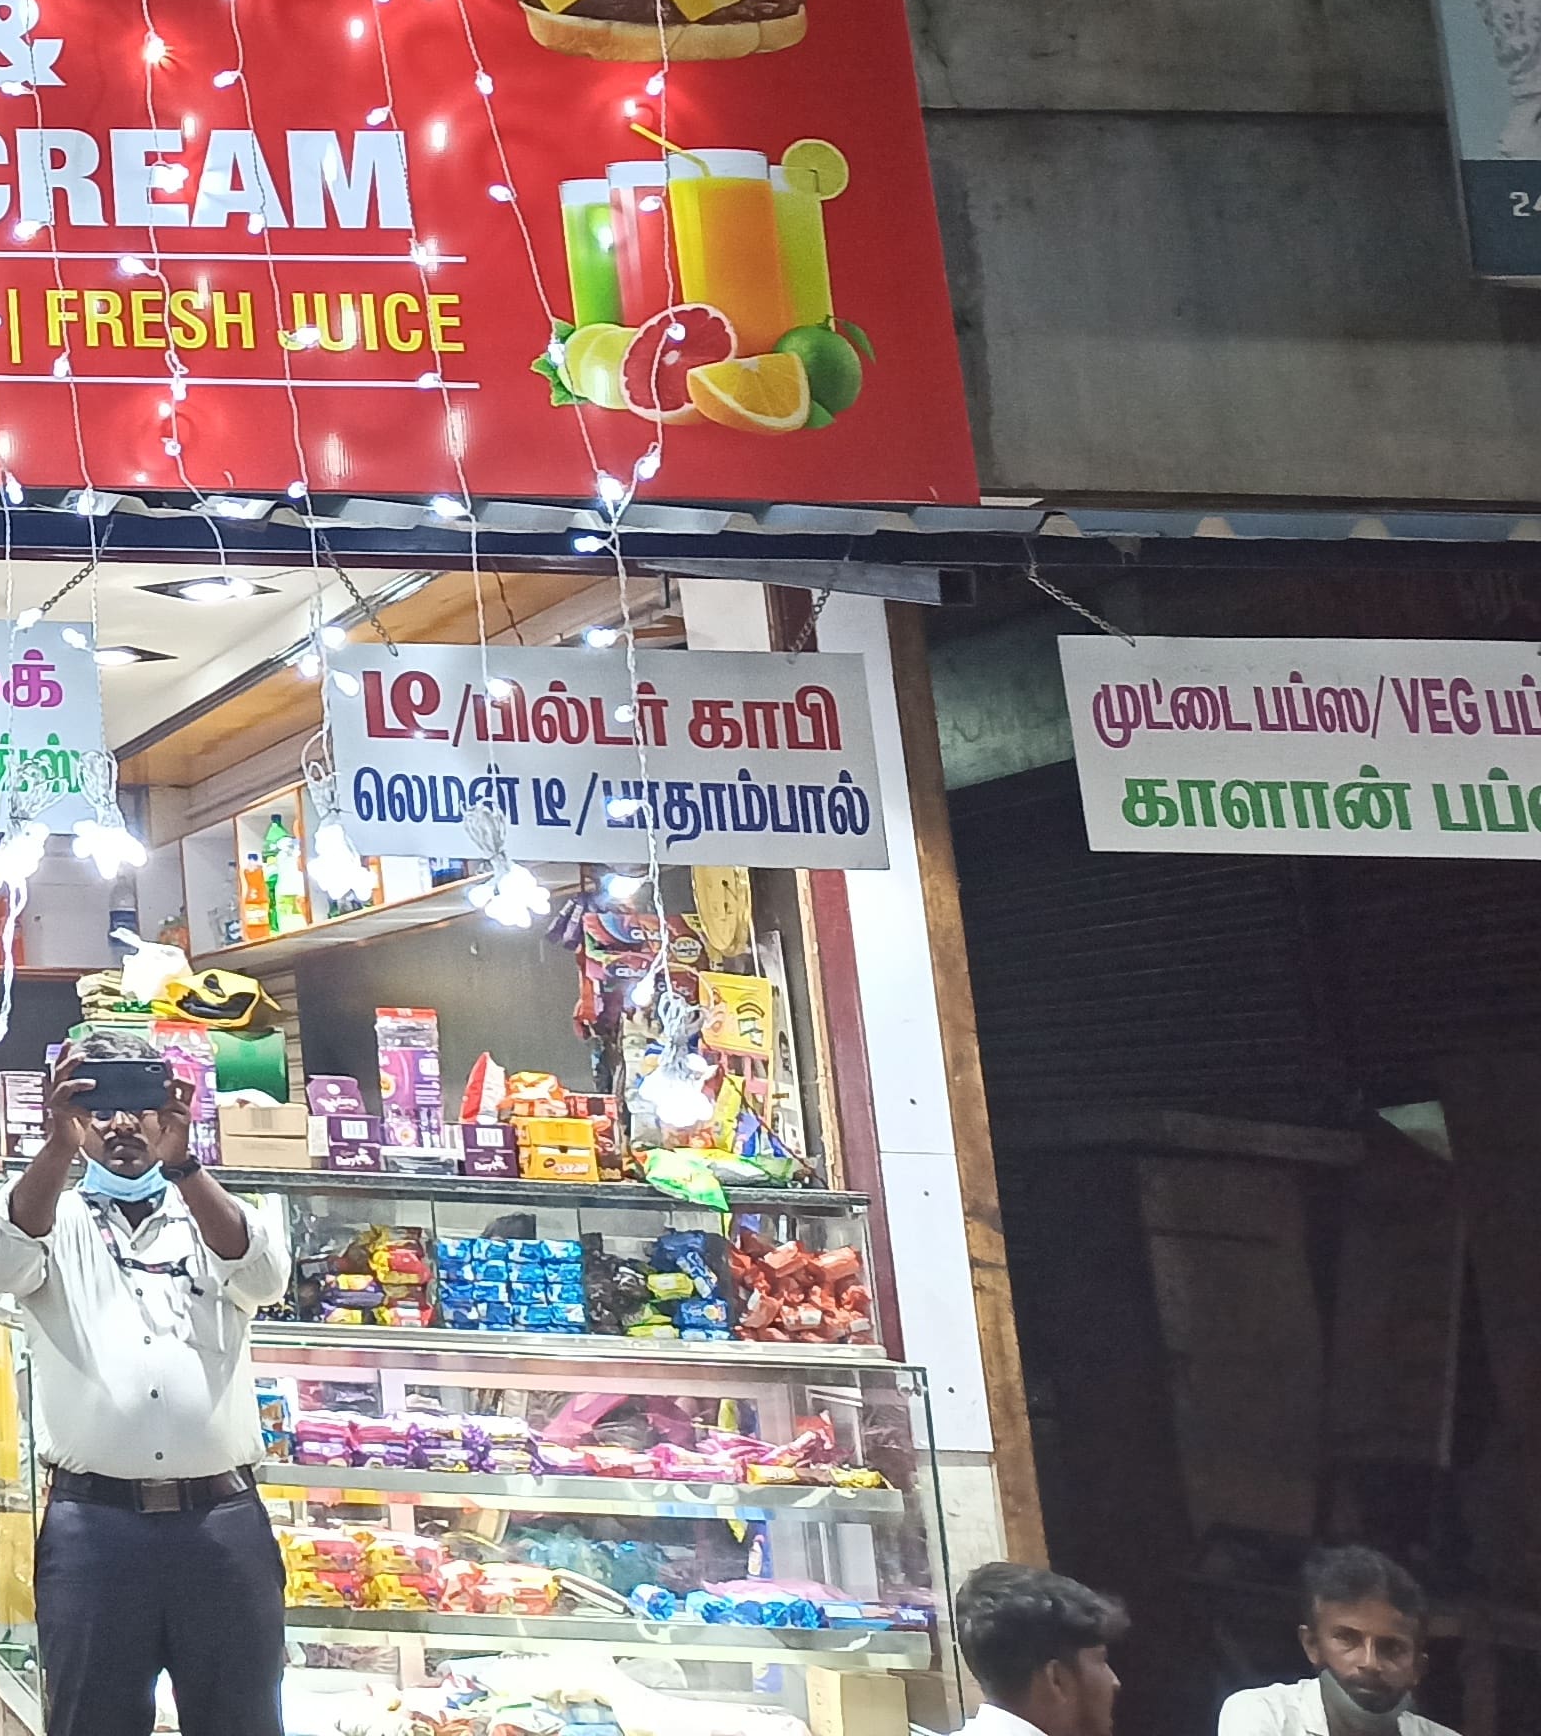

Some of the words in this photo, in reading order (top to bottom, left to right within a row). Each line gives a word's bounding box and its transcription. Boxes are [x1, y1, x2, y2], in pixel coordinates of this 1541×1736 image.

[47, 286, 254, 351] FRESH
[279, 290, 466, 355] JUICE
[688, 684, 843, 752] காபி
[1121, 764, 1412, 831] காளான்
